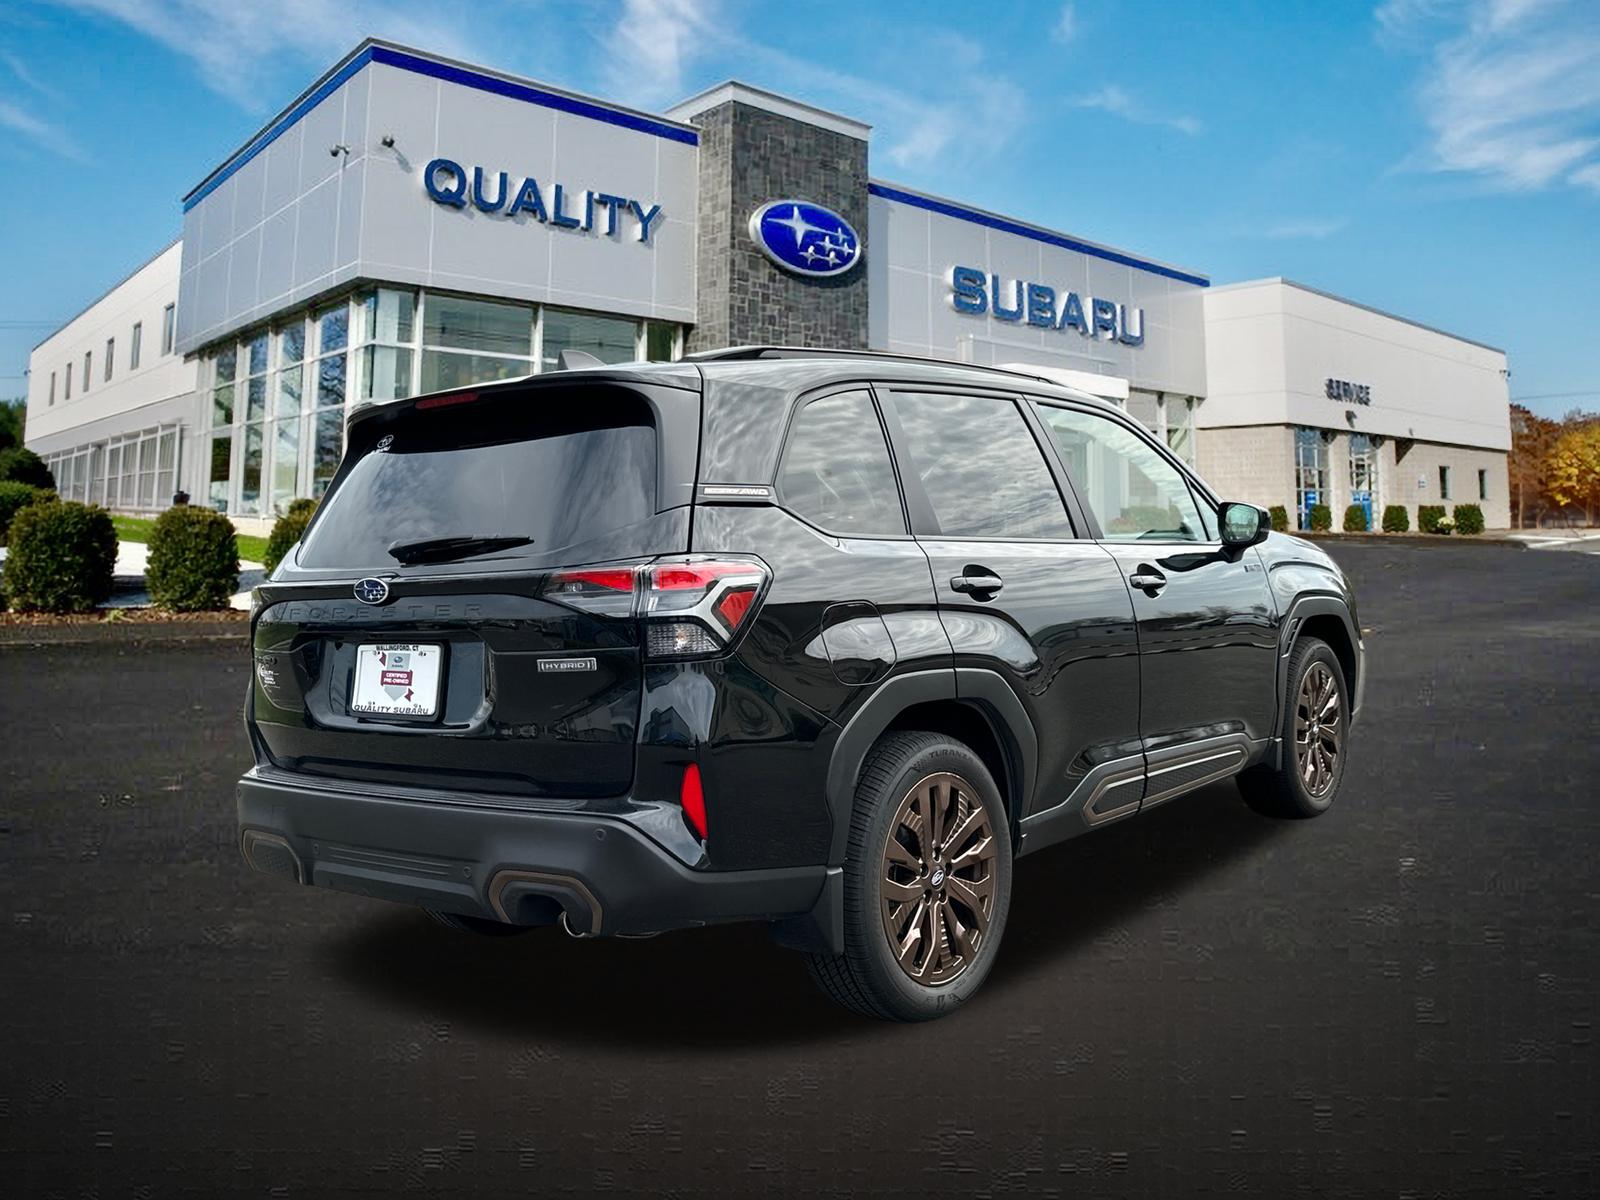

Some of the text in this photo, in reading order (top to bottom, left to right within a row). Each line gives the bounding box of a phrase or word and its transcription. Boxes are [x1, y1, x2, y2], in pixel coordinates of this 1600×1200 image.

[423, 158, 662, 242] QUALITY
[948, 265, 1145, 346] SUBARU
[1324, 378, 1370, 406] SERVICE
[289, 603, 483, 620] FORESTER
[353, 704, 391, 712] QUALITY
